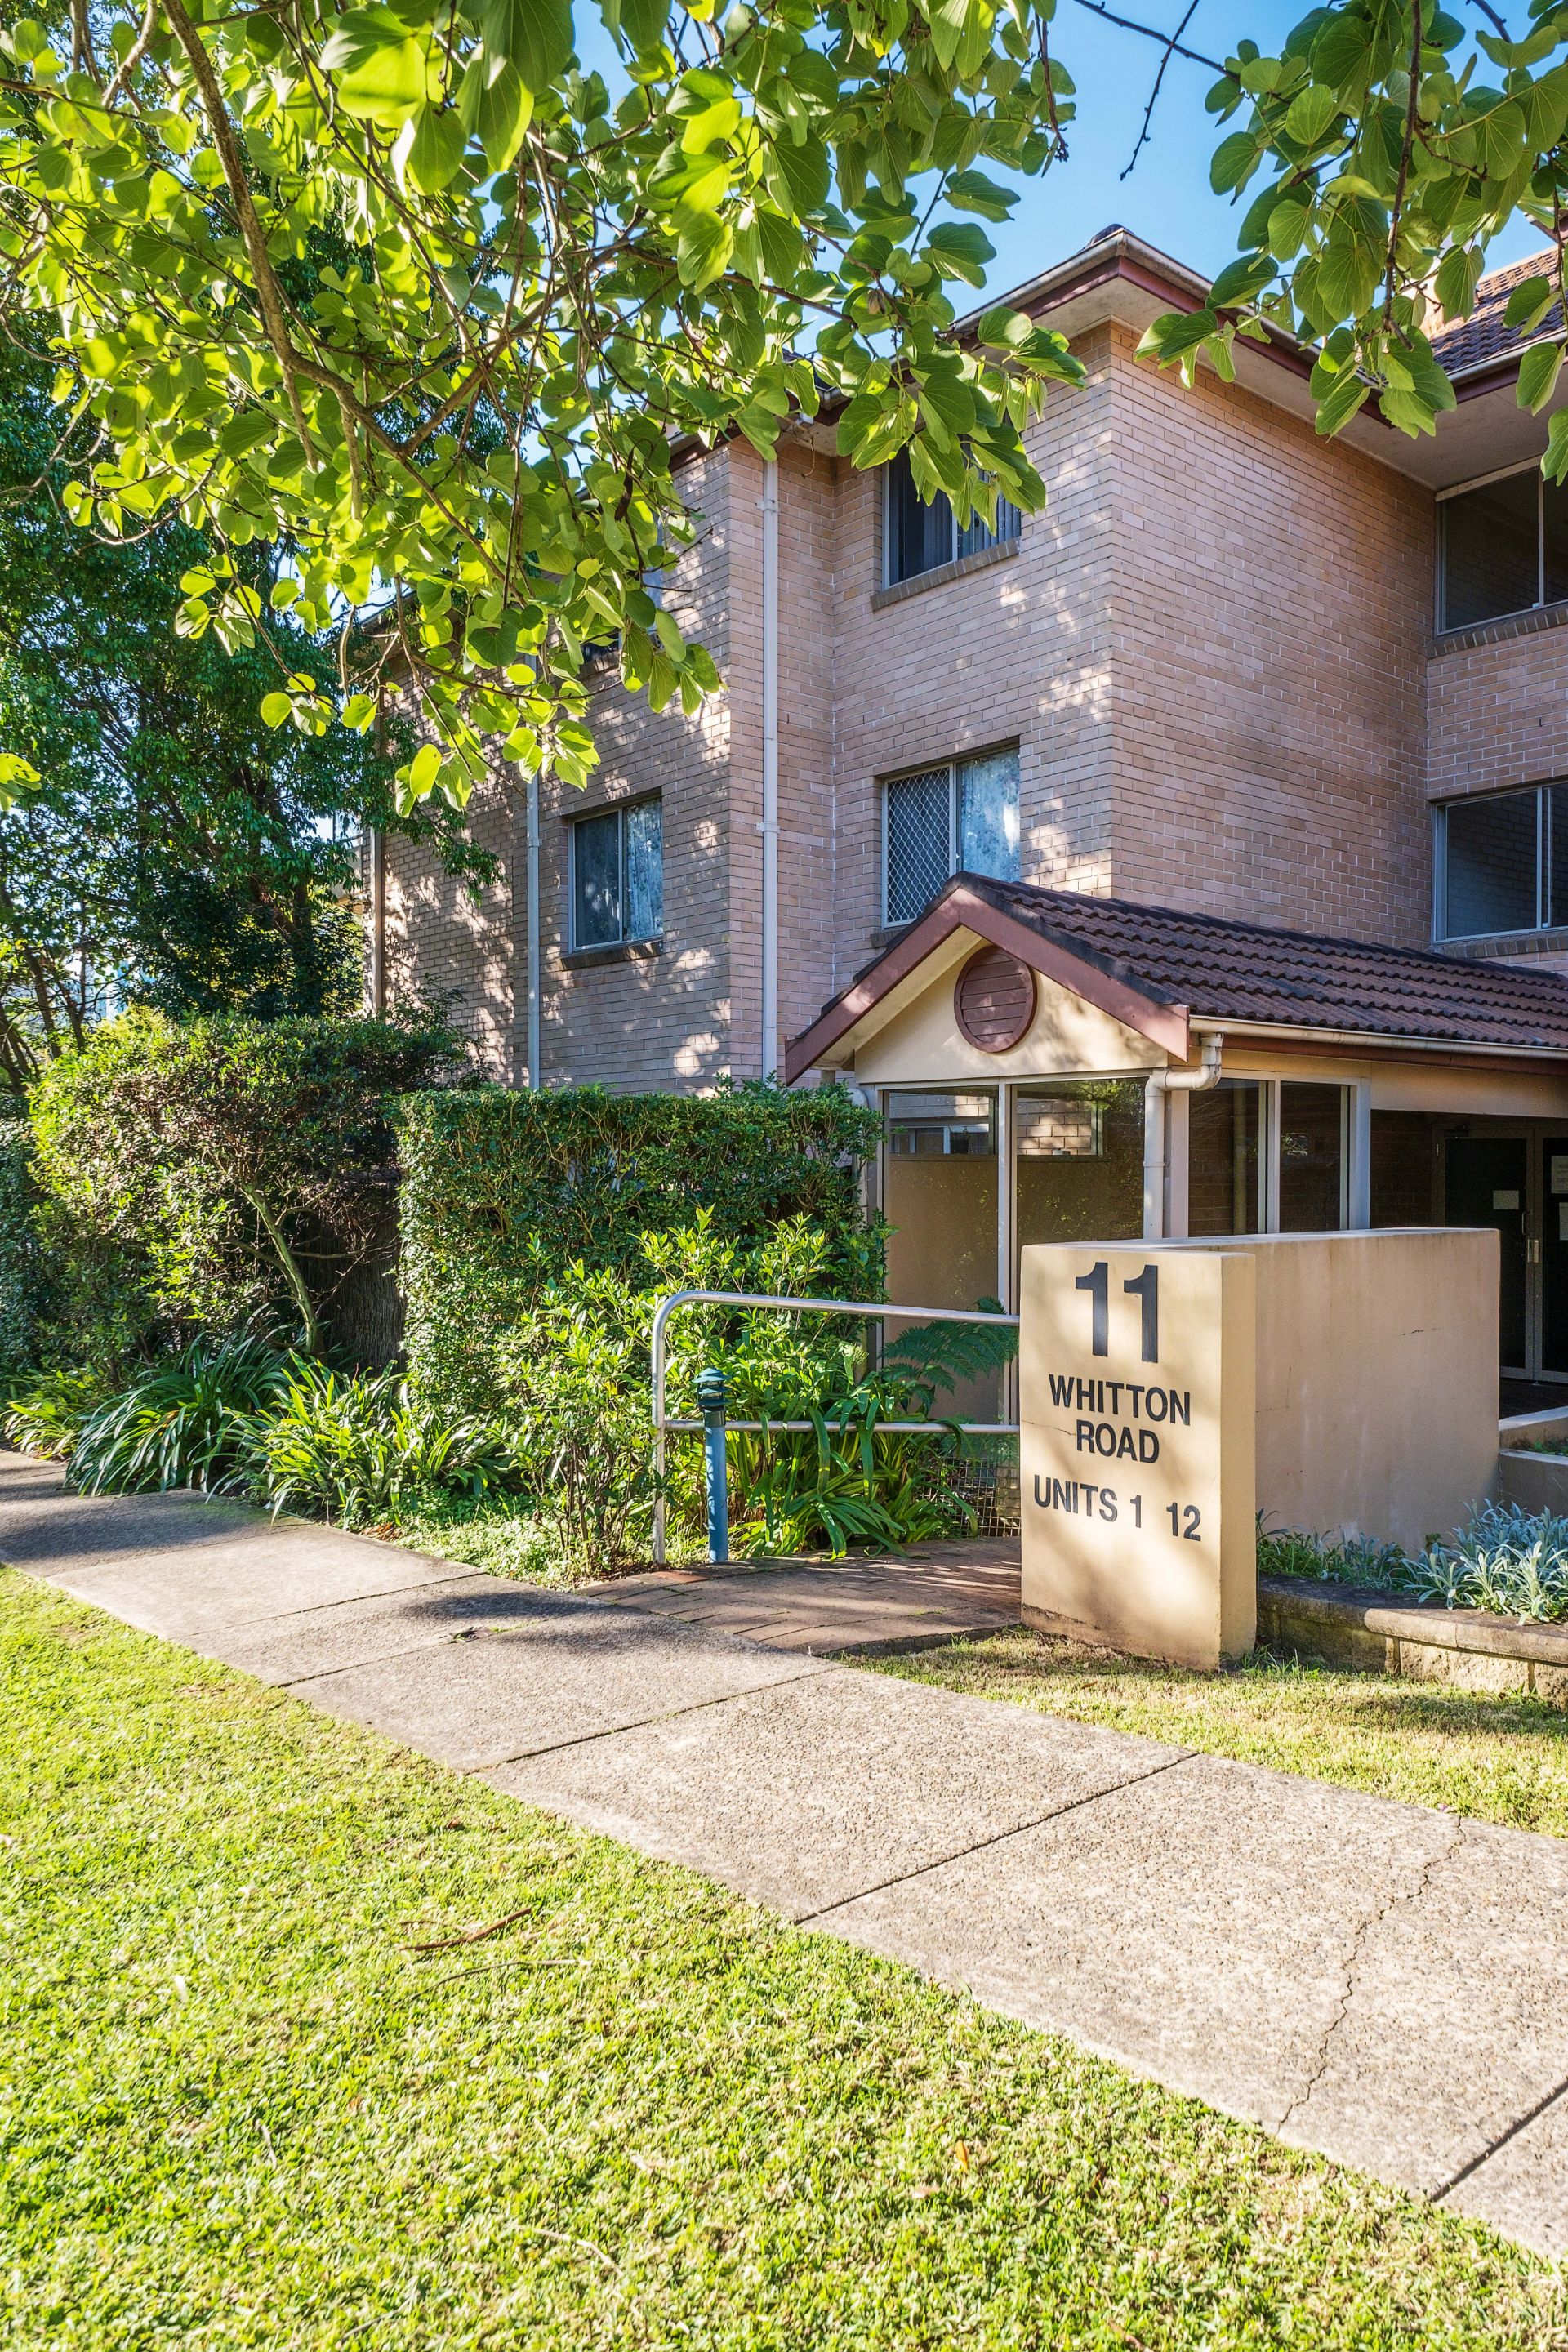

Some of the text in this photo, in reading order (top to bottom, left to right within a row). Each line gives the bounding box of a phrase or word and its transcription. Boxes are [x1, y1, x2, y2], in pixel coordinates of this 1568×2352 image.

[1075, 1262, 1159, 1363] 11
[1048, 1374, 1190, 1426] WHITTON
[1076, 1419, 1160, 1463] ROAD
[1034, 1474, 1201, 1542] UNITS 1 12
